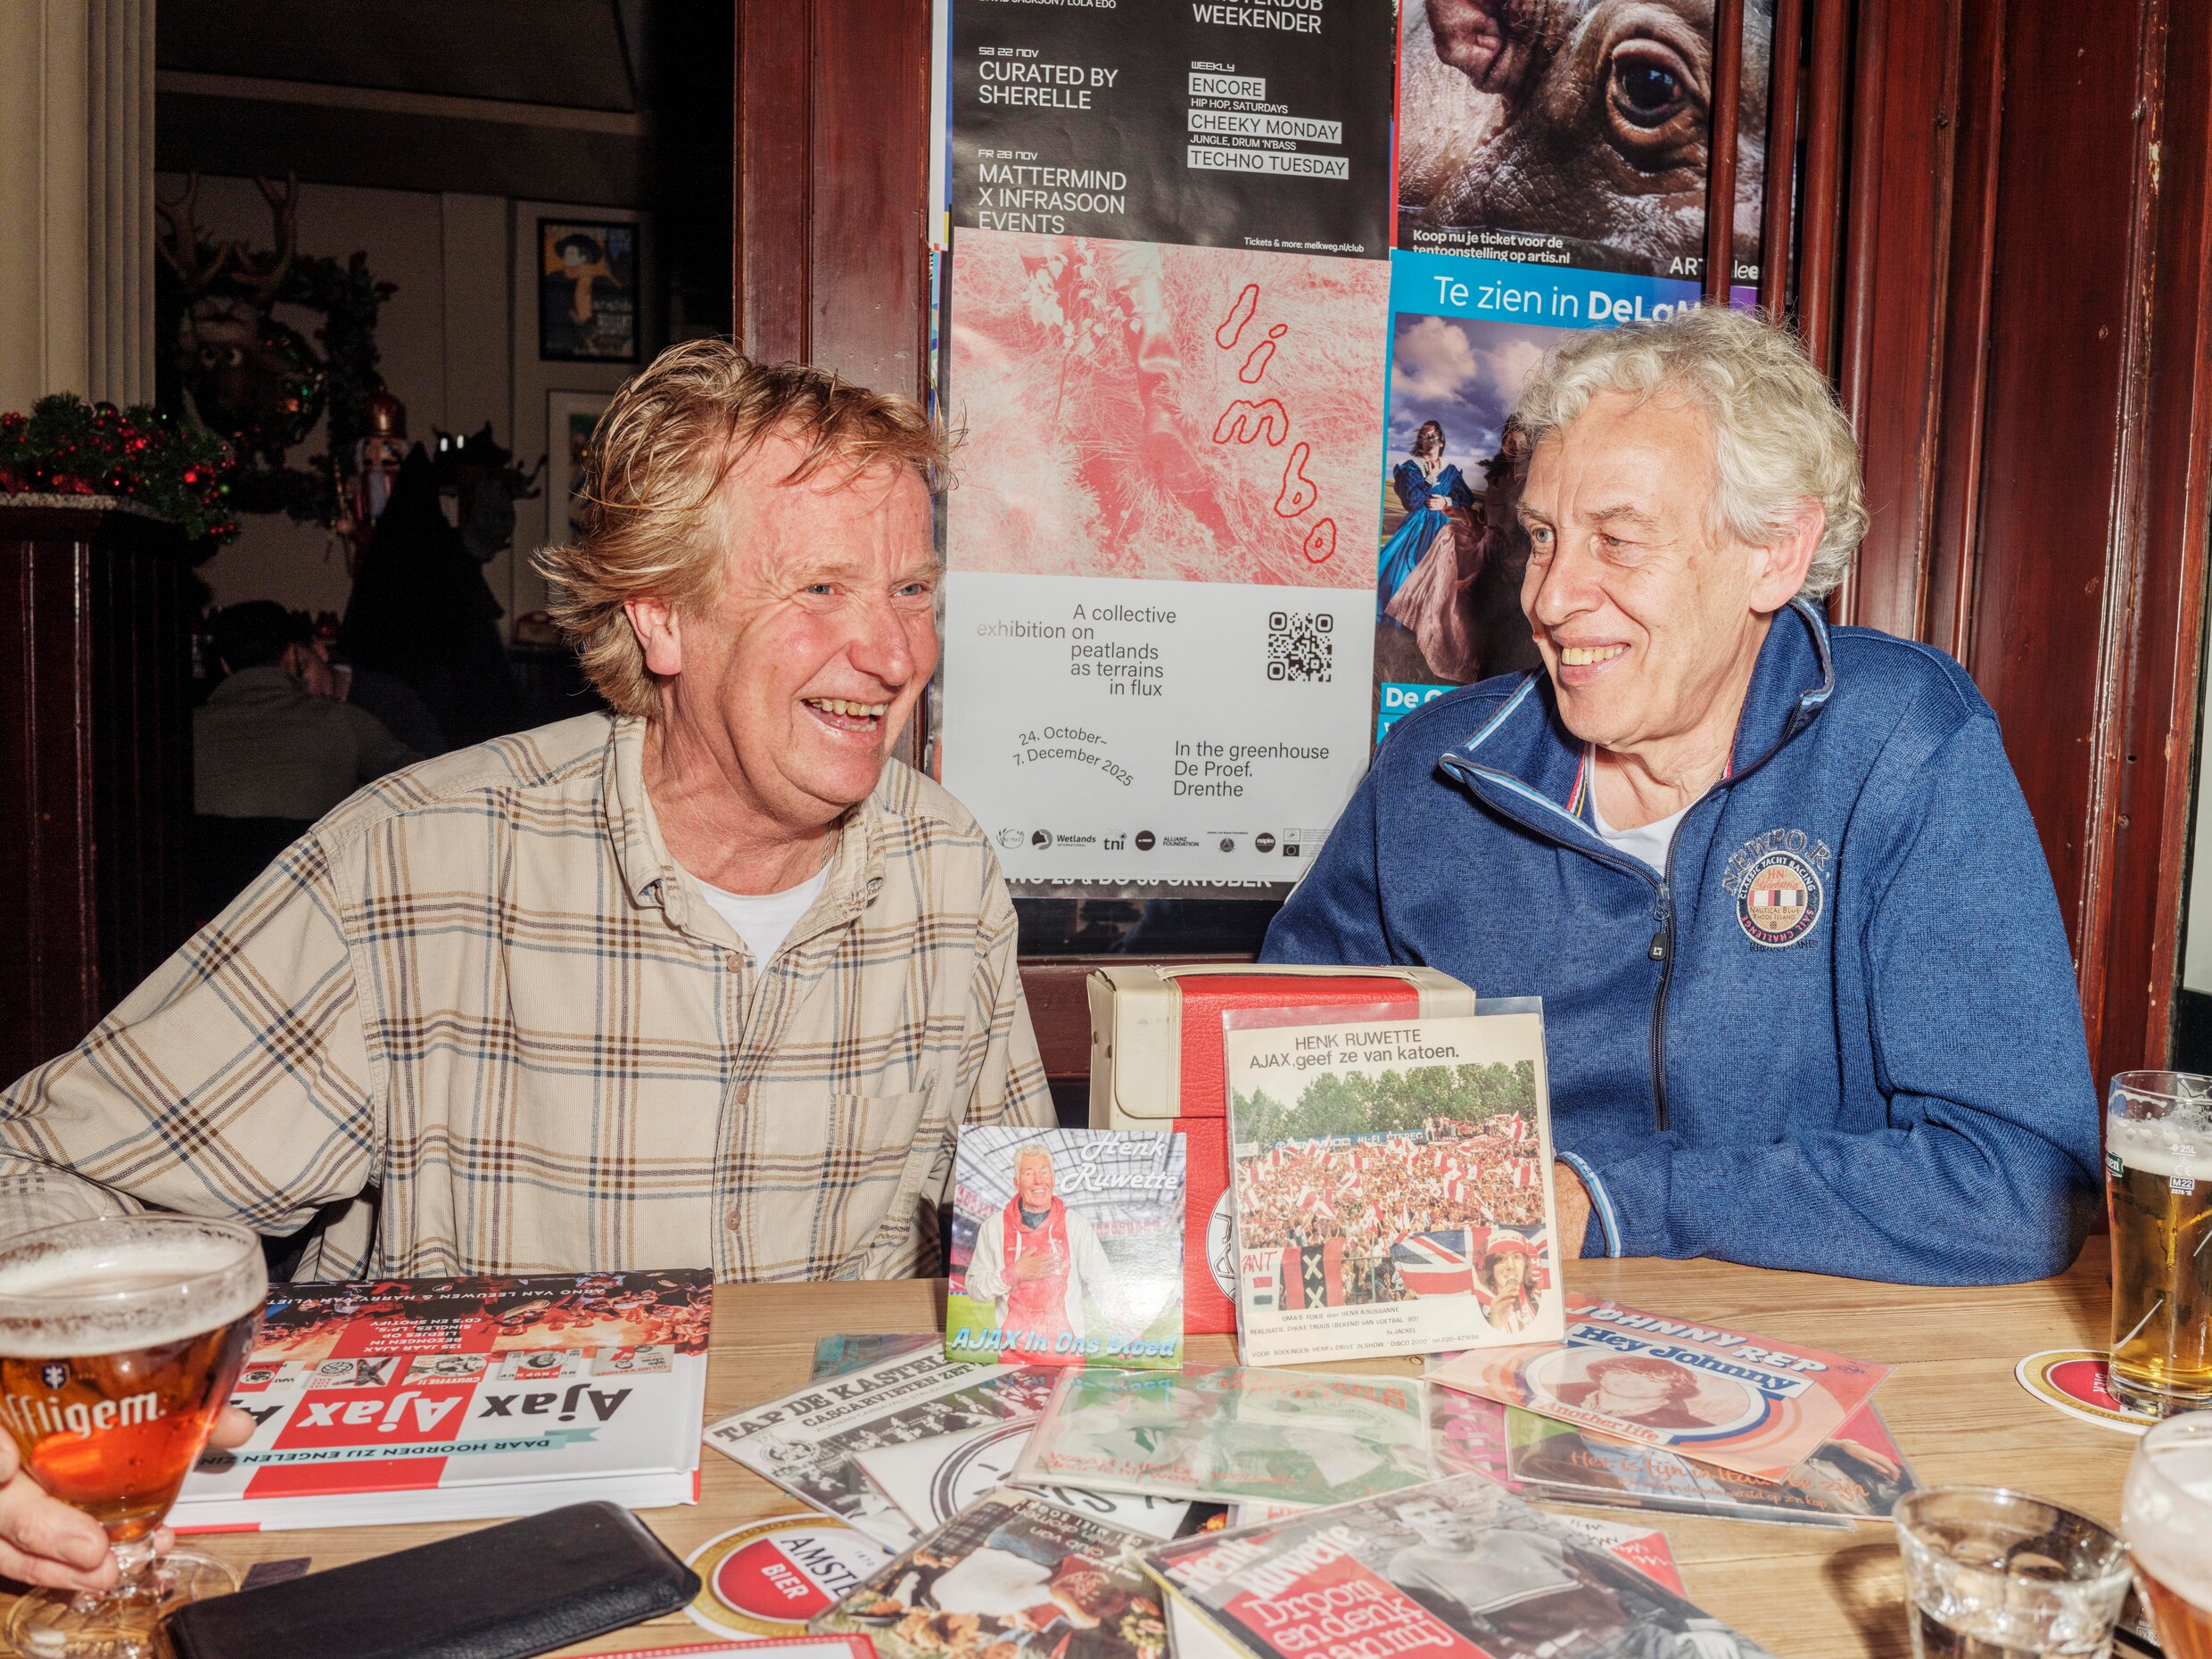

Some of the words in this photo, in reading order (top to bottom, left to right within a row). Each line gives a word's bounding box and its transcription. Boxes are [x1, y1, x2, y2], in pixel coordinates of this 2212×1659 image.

[1095, 0, 1117, 9] EDO
[1193, 4, 1322, 34] WEEKENDER
[997, 48, 1013, 57] 22
[979, 61, 1085, 86] CURATED
[1090, 68, 1118, 87] BY
[1191, 61, 1234, 71] WEEKLY
[1192, 77, 1262, 97] ENCORE
[978, 85, 1092, 109] SHERELLE
[1191, 98, 1208, 107] HIP
[1209, 99, 1231, 111] HOP,
[1233, 101, 1288, 114] SATURDAYS
[1191, 114, 1261, 133] CHEEKY
[1267, 120, 1339, 140] MONDAY
[1190, 134, 1230, 146] JUNGLE,
[1232, 136, 1261, 148] DRUM
[978, 149, 994, 157] FR
[997, 150, 1012, 159] 28
[1191, 150, 1264, 169] TECHNO
[1268, 156, 1346, 176] TUESDAY
[979, 164, 1127, 191] MATTERMIND
[978, 187, 994, 207] X
[999, 188, 1125, 214] INFRASOON
[979, 210, 1065, 234] EVENTS
[1244, 237, 1273, 247] Tickets
[1274, 239, 1280, 247] &
[1304, 242, 1365, 253] melkweg.nl/club
[1413, 230, 1447, 243] Koop
[1449, 234, 1465, 243] nu
[1465, 231, 1479, 246] je
[1481, 232, 1516, 246] ticket
[1517, 237, 1547, 248] voor
[1547, 237, 1563, 248] de
[1509, 251, 1527, 263] op
[1527, 252, 1571, 264] artis.nl
[1434, 276, 1469, 307] Te
[1479, 280, 1541, 316] zien
[1552, 285, 1579, 318] in
[1072, 605, 1086, 621] A
[1092, 605, 1177, 623] collective
[977, 620, 1065, 639] exhibition
[1072, 624, 1094, 640] on
[1070, 642, 1160, 660] peatlands
[1070, 662, 1091, 676] as
[1096, 662, 1164, 679] terrains
[1110, 680, 1126, 696] in
[1130, 680, 1163, 697] flux
[1386, 687, 1418, 708] De
[1019, 729, 1040, 746] 24.
[1176, 740, 1191, 756] In
[1197, 740, 1224, 756] the
[1229, 742, 1329, 762] greenhouse
[1013, 753, 1025, 767] 7.
[1028, 747, 1101, 767] December
[1102, 759, 1135, 787] 2025
[1175, 761, 1199, 776] De
[1204, 760, 1252, 777] Proef.
[1174, 780, 1243, 797] Drenthe
[1056, 835, 1096, 843] Wetlands
[1103, 835, 1125, 850] tni
[1739, 866, 1762, 899] CLASSIC
[1761, 856, 1787, 868] YACHT
[1789, 861, 1816, 892] RACING
[1768, 869, 1784, 879] HN
[1741, 915, 1794, 942] CHALLENGE
[1795, 908, 1815, 931] SAIL
[1295, 1035, 1340, 1051] HENK
[1345, 1029, 1422, 1047] RUWETTE
[1340, 1051, 1358, 1063] ze
[1364, 1050, 1392, 1062] van
[1397, 1045, 1460, 1061] katoen.
[1081, 1131, 1165, 1160] Henk
[1060, 1161, 1177, 1193] Ruwette
[2173, 1179, 2192, 1187] M22
[268, 1298, 315, 1306] VLIET
[320, 1296, 348, 1304] VAN
[441, 1292, 517, 1300] LEEUWEN
[1375, 1317, 1404, 1325] VOETBAL
[390, 1337, 462, 1345] BEZONGEN
[951, 1327, 1022, 1351] AJAX
[1026, 1335, 1048, 1352] In
[1054, 1333, 1100, 1354] Ons
[1106, 1337, 1177, 1358] Bloed
[1566, 1305, 1748, 1349] JOHNNY
[1730, 1345, 1830, 1373] REP
[1274, 1347, 1309, 1356] BOEKINGEN
[1573, 1325, 1645, 1356] Hey
[1649, 1343, 1802, 1391] Johnny
[479, 1383, 633, 1422] Ajax
[803, 1375, 942, 1427] CASCARVIETEN
[942, 1363, 972, 1381] ZET
[296, 1391, 463, 1433] Ajax
[712, 1404, 786, 1443] TAP
[781, 1393, 835, 1416] DE
[1539, 1400, 1622, 1430] Another
[346, 1447, 378, 1458] ZIJ
[384, 1440, 492, 1457] HOORDEN
[495, 1438, 551, 1449] DAAR
[199, 1455, 237, 1467] ZIN
[244, 1449, 341, 1465] ENGELEN
[1620, 1454, 1643, 1472] is
[1013, 1504, 1078, 1534] dromen
[1029, 1525, 1061, 1543] van
[1164, 1538, 1270, 1593] Henk
[1229, 1525, 1365, 1599] Ruwette
[762, 1563, 810, 1600] BIER
[1242, 1579, 1386, 1627] Droom
[1387, 1618, 1455, 1650] mij
